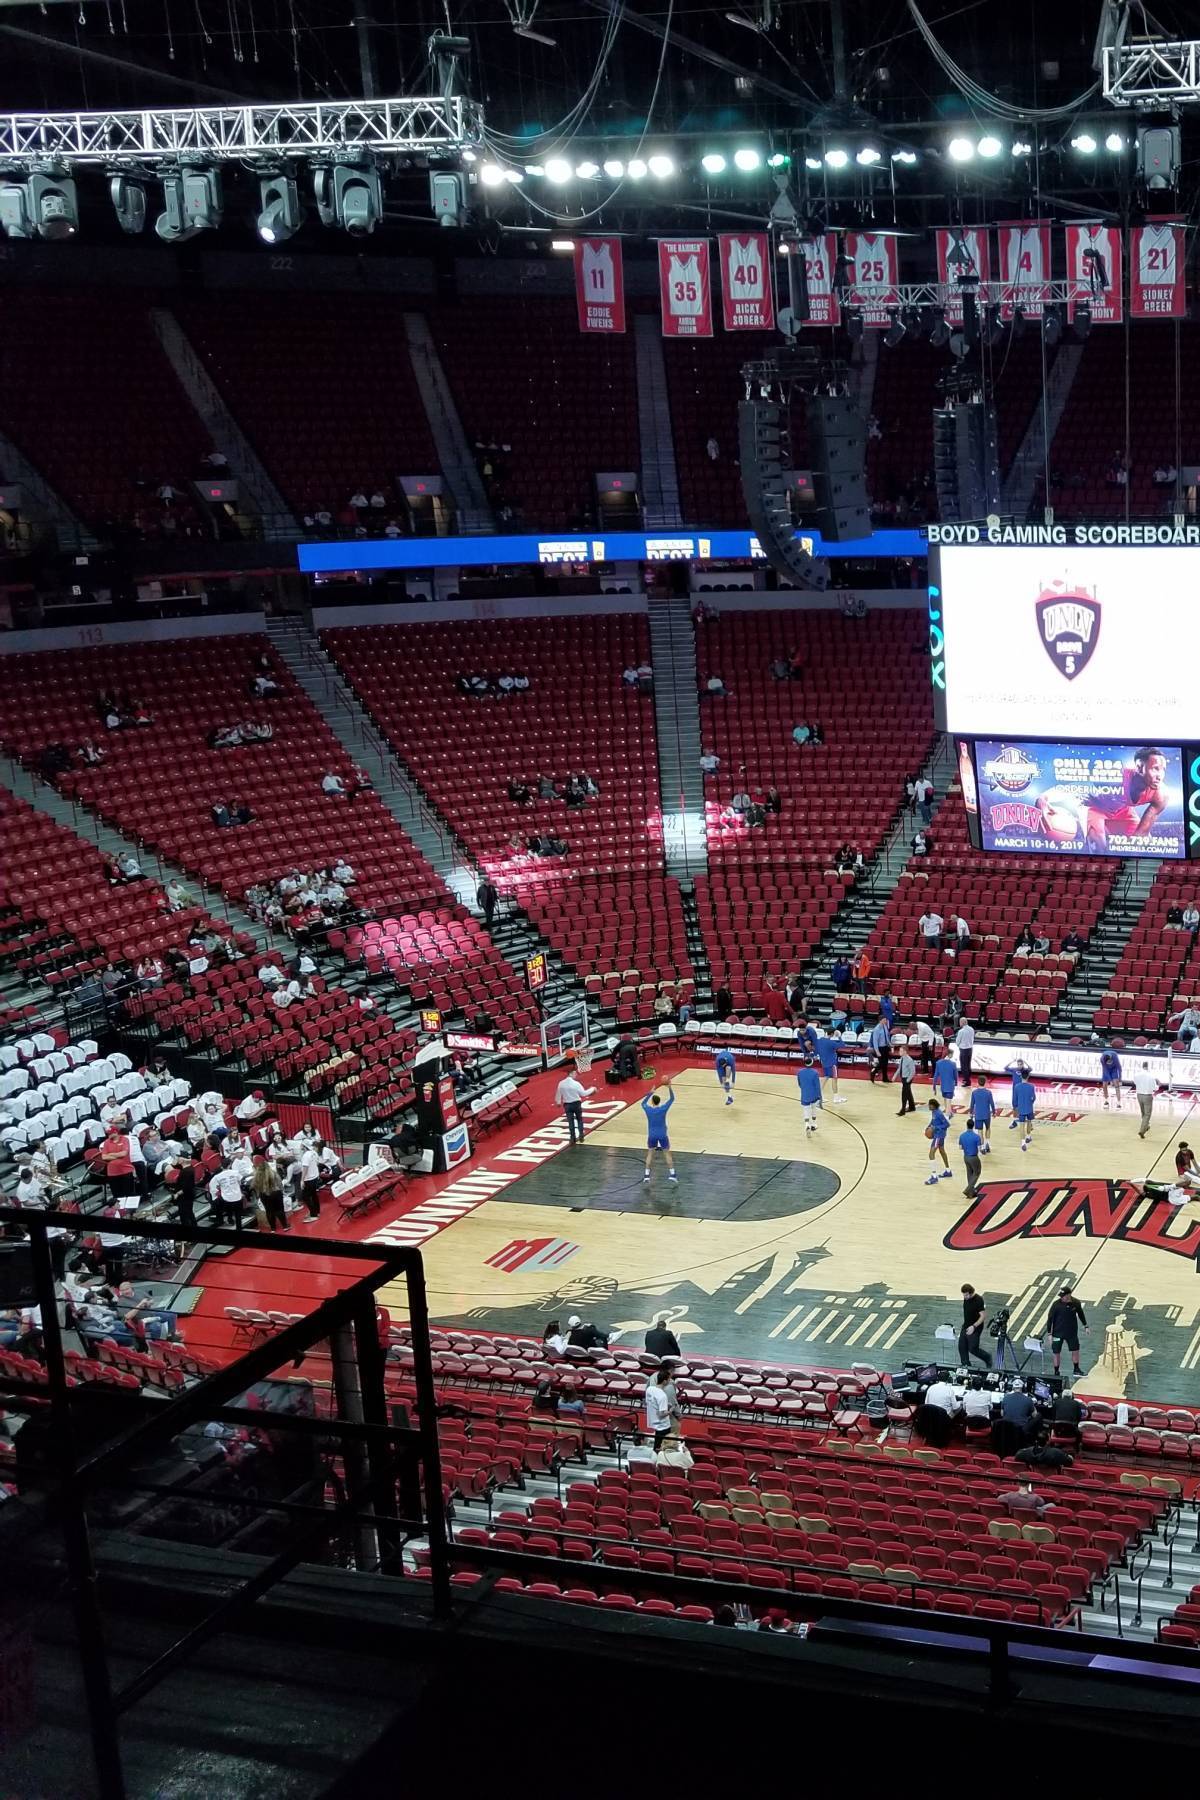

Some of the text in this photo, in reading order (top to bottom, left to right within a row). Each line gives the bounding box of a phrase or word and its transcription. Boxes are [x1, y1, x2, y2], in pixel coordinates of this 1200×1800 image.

[1019, 251, 1032, 273] 4
[1147, 248, 1169, 270] 21
[734, 265, 757, 285] 40
[805, 260, 824, 280] 23
[861, 261, 884, 282] 25
[590, 269, 605, 289] 11
[674, 282, 697, 301] 35
[1143, 289, 1173, 300] SIDNEY
[736, 304, 760, 313] RICKY
[808, 298, 829, 309] EGGIE
[588, 307, 610, 317] EDDIE
[733, 315, 765, 326] SOBERS
[928, 525, 979, 543] BOYD
[987, 526, 1067, 544] GAMING
[1043, 602, 1095, 642] UNLV
[1053, 758, 1090, 769] ONLY
[1054, 785, 1124, 796] ORDER NOW!
[990, 802, 1043, 833] UNLV
[994, 837, 1084, 850] MARCH 10-16, 2019
[1109, 835, 1179, 847] 702.739.FANS
[530, 967, 543, 986] 30
[425, 1020, 438, 1029] 30
[446, 1127, 464, 1141] Chevron
